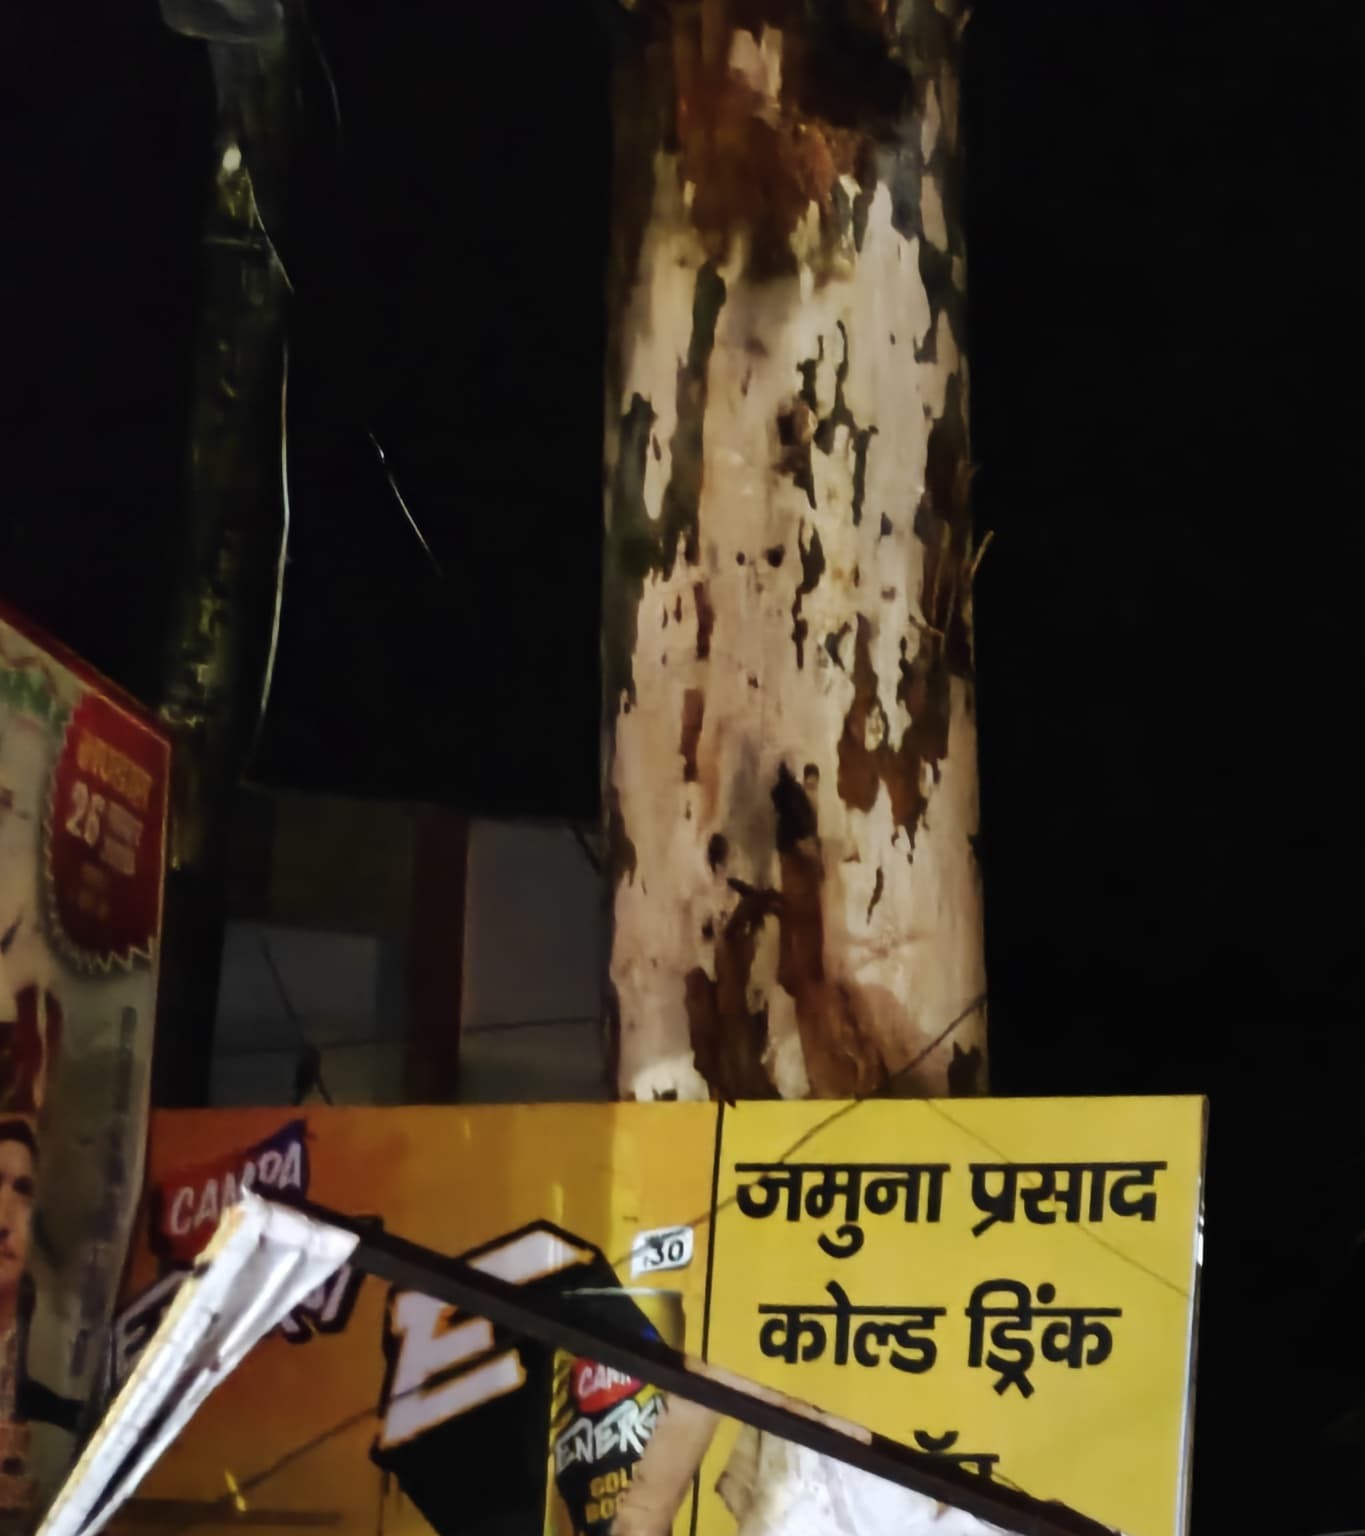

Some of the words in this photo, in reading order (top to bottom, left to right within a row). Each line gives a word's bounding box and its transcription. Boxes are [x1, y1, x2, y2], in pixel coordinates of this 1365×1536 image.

[735, 1161, 950, 1258] जमुना
[969, 1161, 1167, 1237] प्रसाद
[758, 1281, 946, 1374] कोल्ड
[964, 1278, 1121, 1398] ड्रिंक
